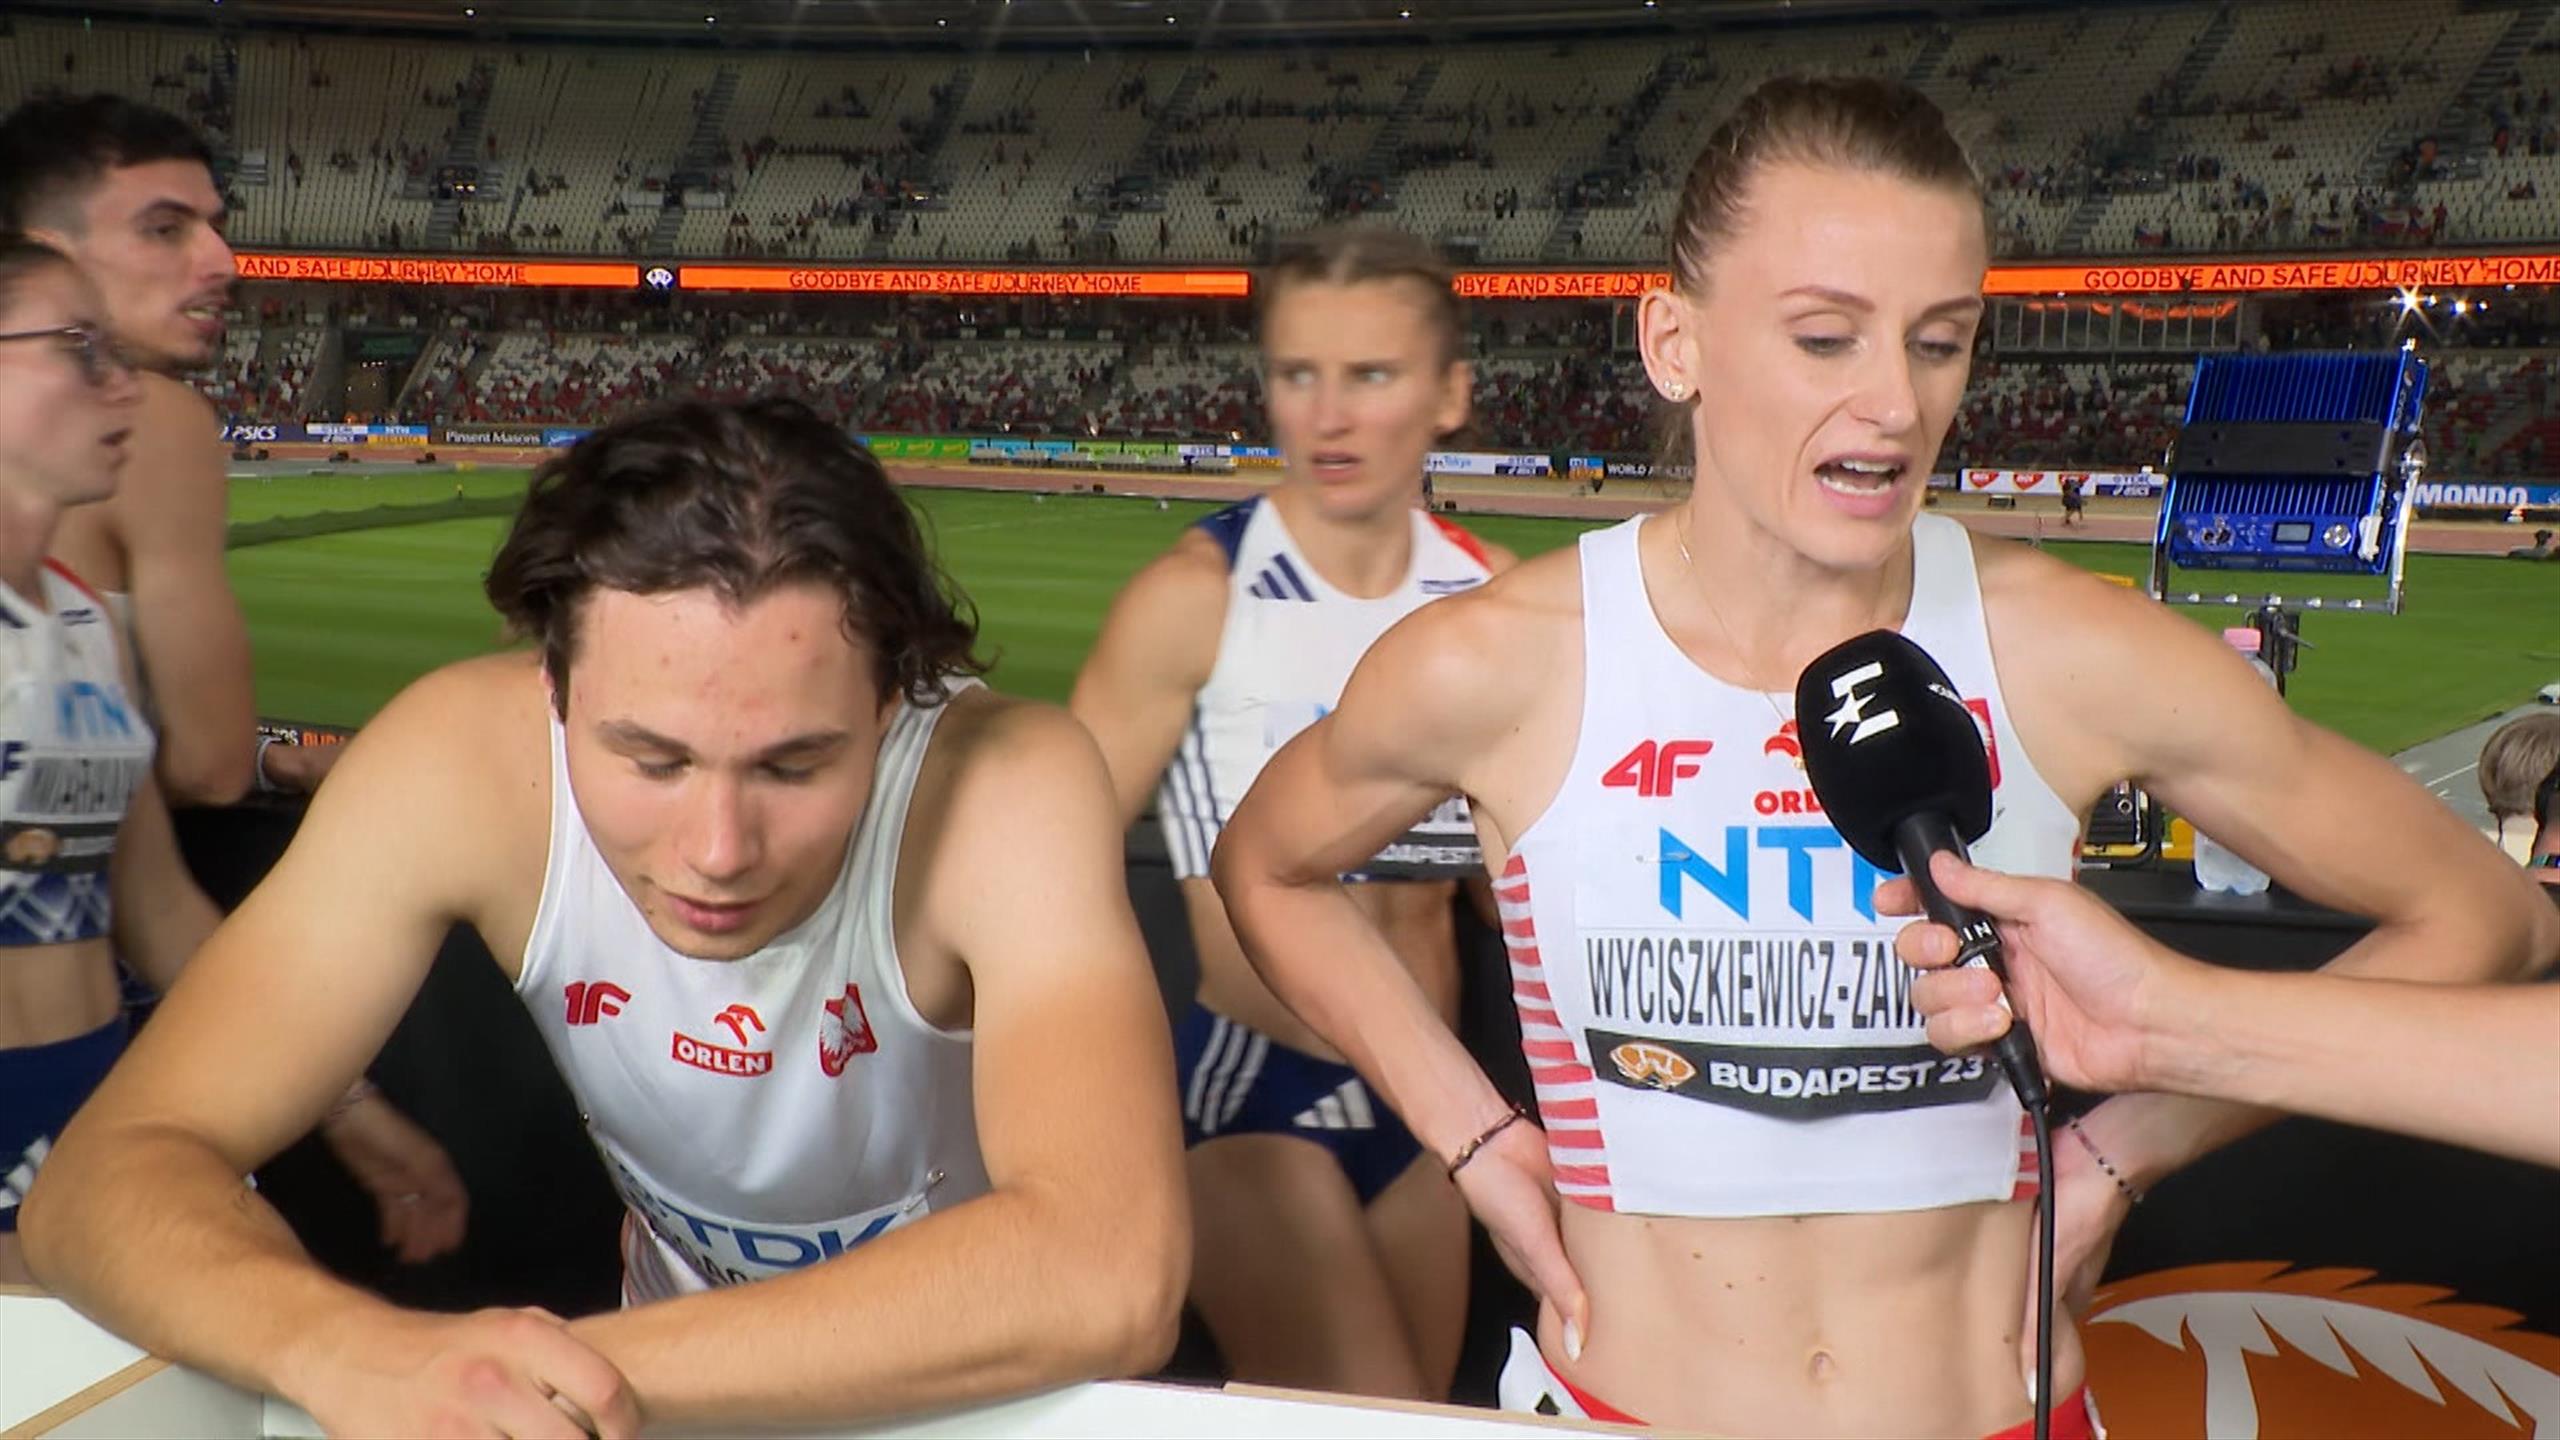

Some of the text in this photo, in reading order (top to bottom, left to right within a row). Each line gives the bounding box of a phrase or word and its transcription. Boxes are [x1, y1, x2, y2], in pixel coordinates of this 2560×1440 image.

[243, 258, 290, 276] AND
[297, 260, 349, 277] SAFE
[463, 264, 526, 282] HOME
[789, 272, 1141, 292] GOODBYE AND SAFE JOURNEY HOME
[2084, 268, 2204, 289] GOODBYE
[2211, 267, 2265, 287] AND
[2273, 264, 2338, 286] SAFE
[2345, 262, 2474, 285] JOURNEY
[1505, 275, 1549, 294] AND
[1554, 275, 1606, 294] SAFE
[1611, 274, 1668, 294] JOUR
[2415, 484, 2529, 505] MONDO
[1602, 739, 1714, 798] 4F
[1754, 789, 1822, 815] ORL
[1586, 936, 1927, 1030] WYCISZKIEWICZ-ZAW
[676, 1037, 767, 1075] ORLEN
[1709, 1056, 1985, 1098] BUDAPEST 23
